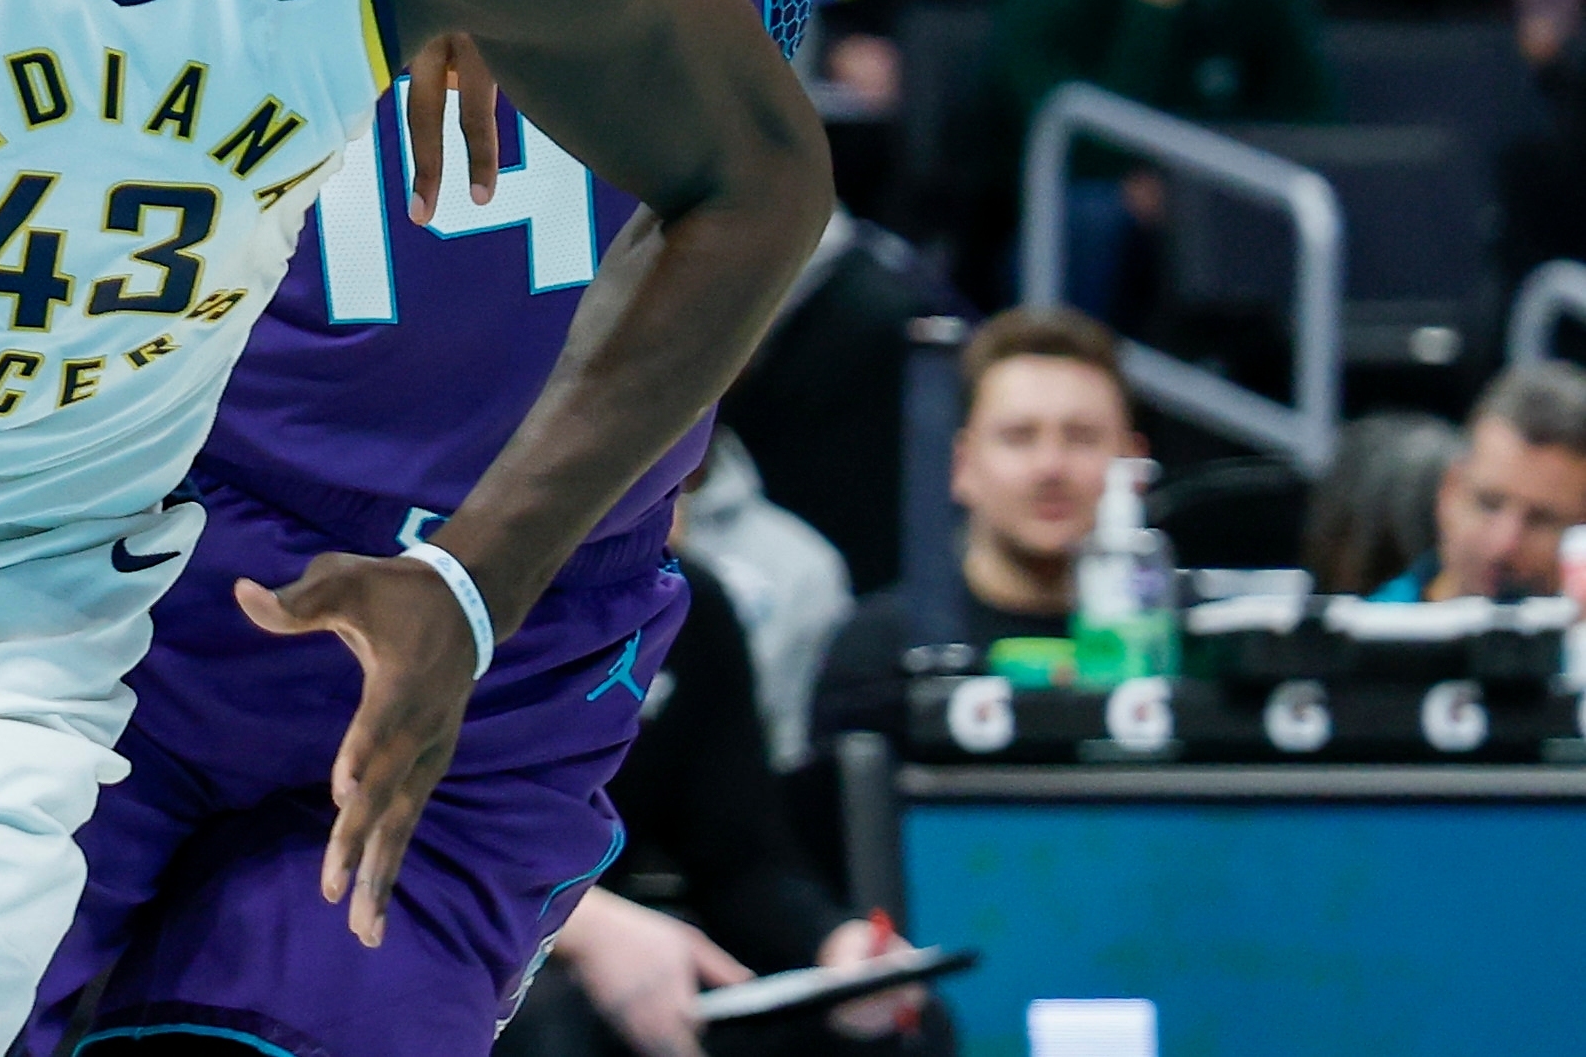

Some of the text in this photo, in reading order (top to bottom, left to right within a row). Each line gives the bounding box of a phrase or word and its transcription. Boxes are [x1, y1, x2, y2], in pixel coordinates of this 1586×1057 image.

[315, 74, 600, 325] 14
[947, 675, 1015, 754] G
[1106, 675, 1174, 754] G
